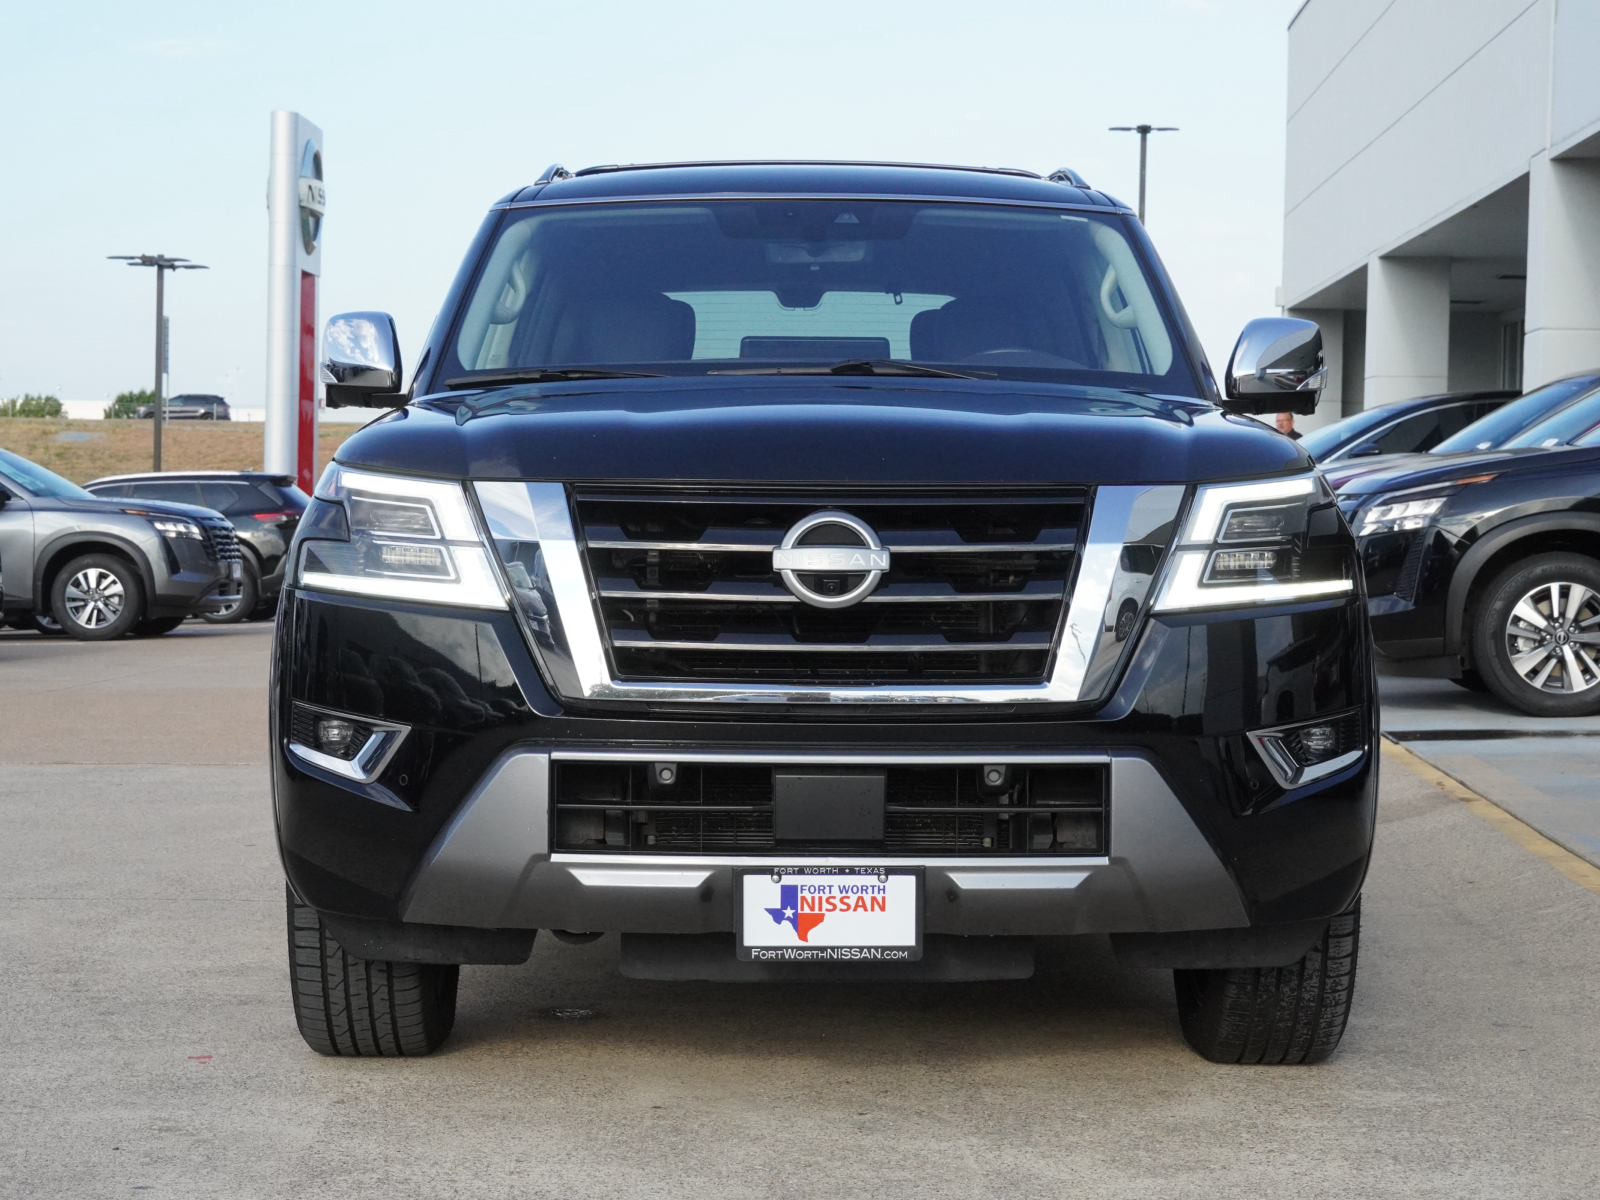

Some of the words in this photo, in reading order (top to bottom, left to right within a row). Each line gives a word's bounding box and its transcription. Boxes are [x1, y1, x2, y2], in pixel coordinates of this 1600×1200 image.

[777, 553, 886, 567] NISSAN
[774, 867, 799, 875] FORT
[804, 867, 839, 875] WORTH
[854, 867, 886, 875] TEXAS
[800, 885, 834, 895] FORT
[838, 885, 886, 895] WORTH
[800, 895, 886, 912] NISSAN
